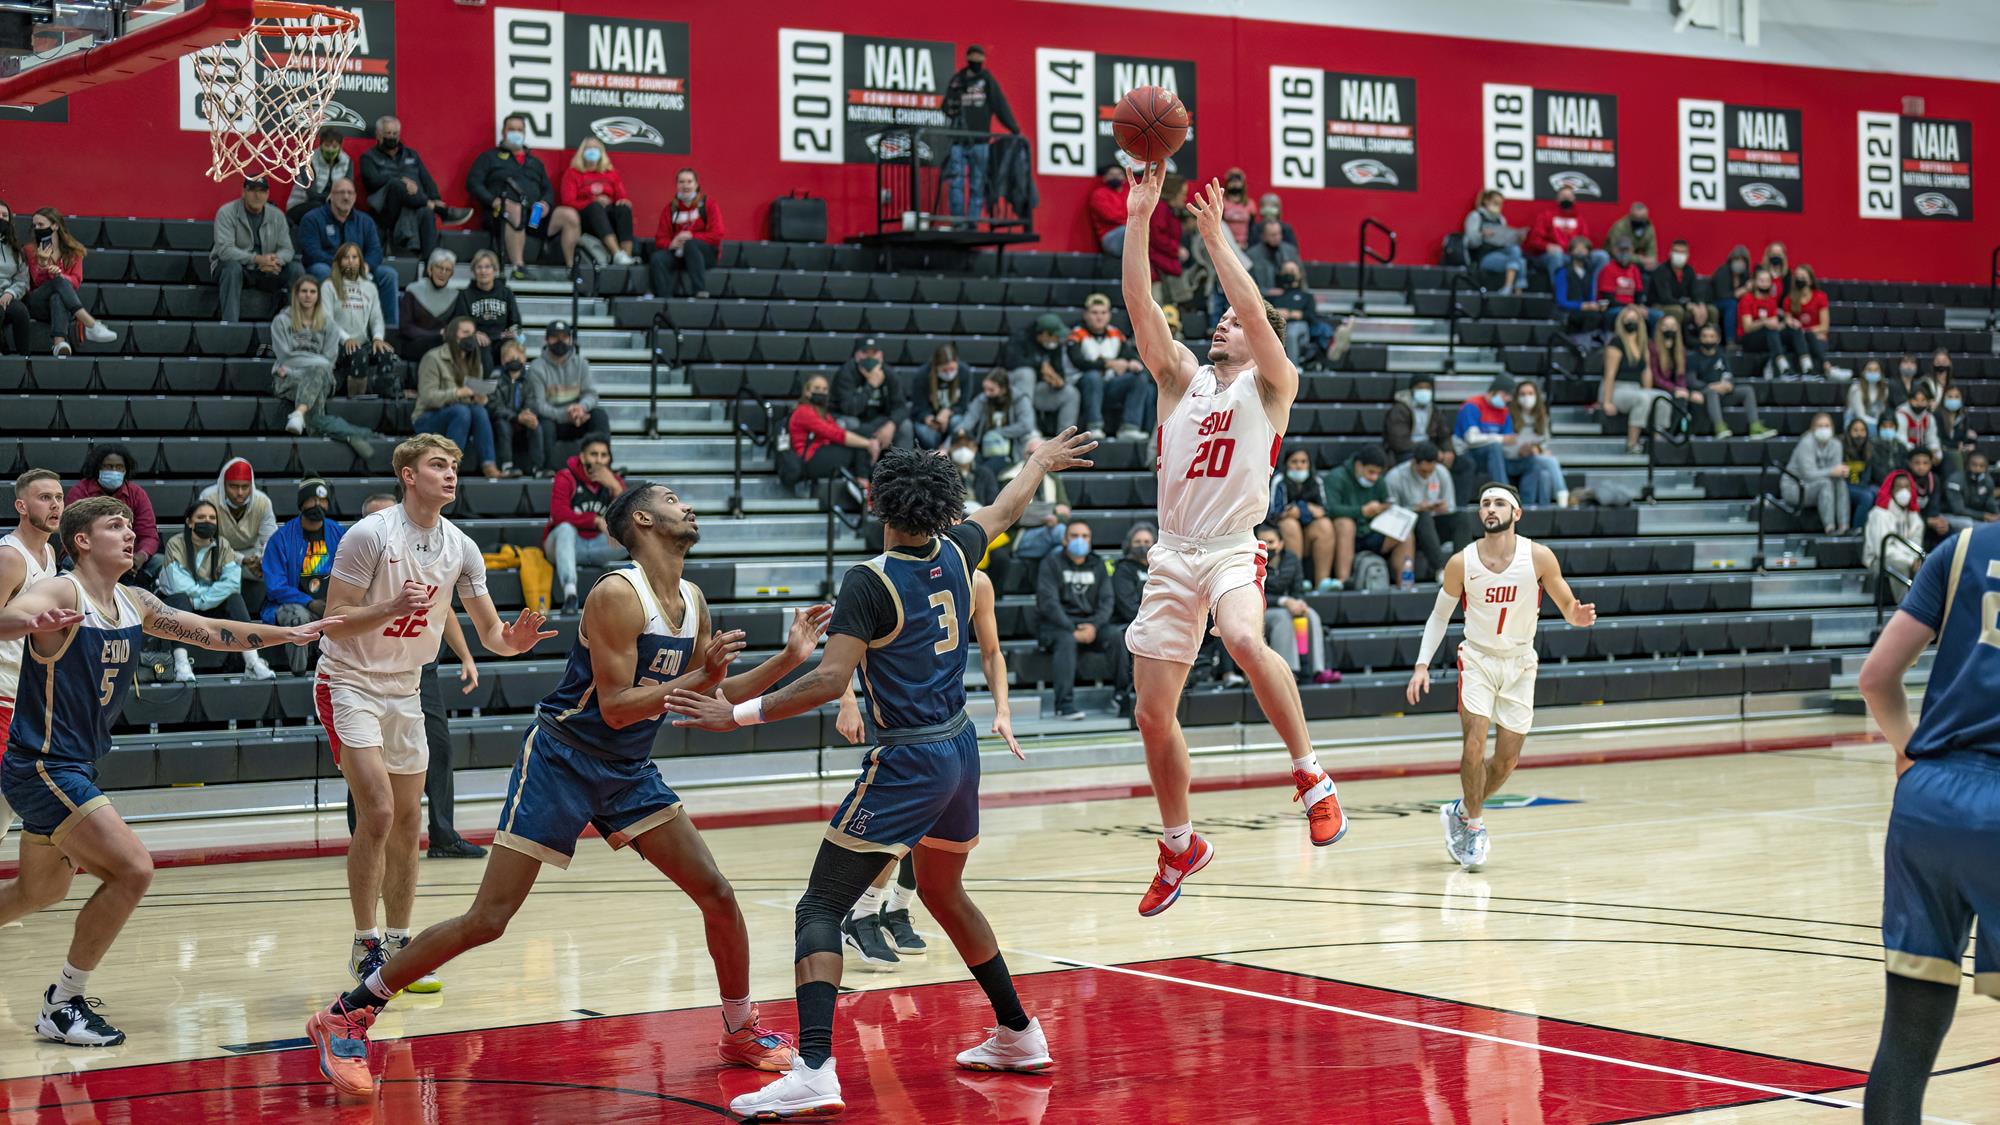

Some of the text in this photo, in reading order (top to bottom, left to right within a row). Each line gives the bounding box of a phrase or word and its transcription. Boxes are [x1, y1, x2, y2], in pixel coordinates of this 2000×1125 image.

[589, 24, 667, 74] NAIA
[864, 44, 935, 91] NAIA
[509, 20, 551, 138] 2010
[570, 88, 685, 111] NATIONAL CHAMPIONS
[793, 41, 831, 152] 2010
[1049, 60, 1084, 165] 2014
[1340, 80, 1400, 122] NAIA
[1548, 96, 1603, 137] NAIA
[1282, 77, 1313, 178] 2016
[1495, 94, 1523, 190] 2018
[1738, 111, 1789, 151] NAIA
[1912, 122, 1960, 162] NAIA
[1690, 110, 1716, 201] 2019
[1867, 121, 1893, 210] 2021
[1198, 409, 1234, 436] SOU
[1186, 438, 1236, 479] 20
[1485, 585, 1518, 603] SOU
[928, 589, 959, 655] 3
[1497, 607, 1507, 635] 1
[99, 668, 120, 706] 5
[849, 808, 875, 835] E
